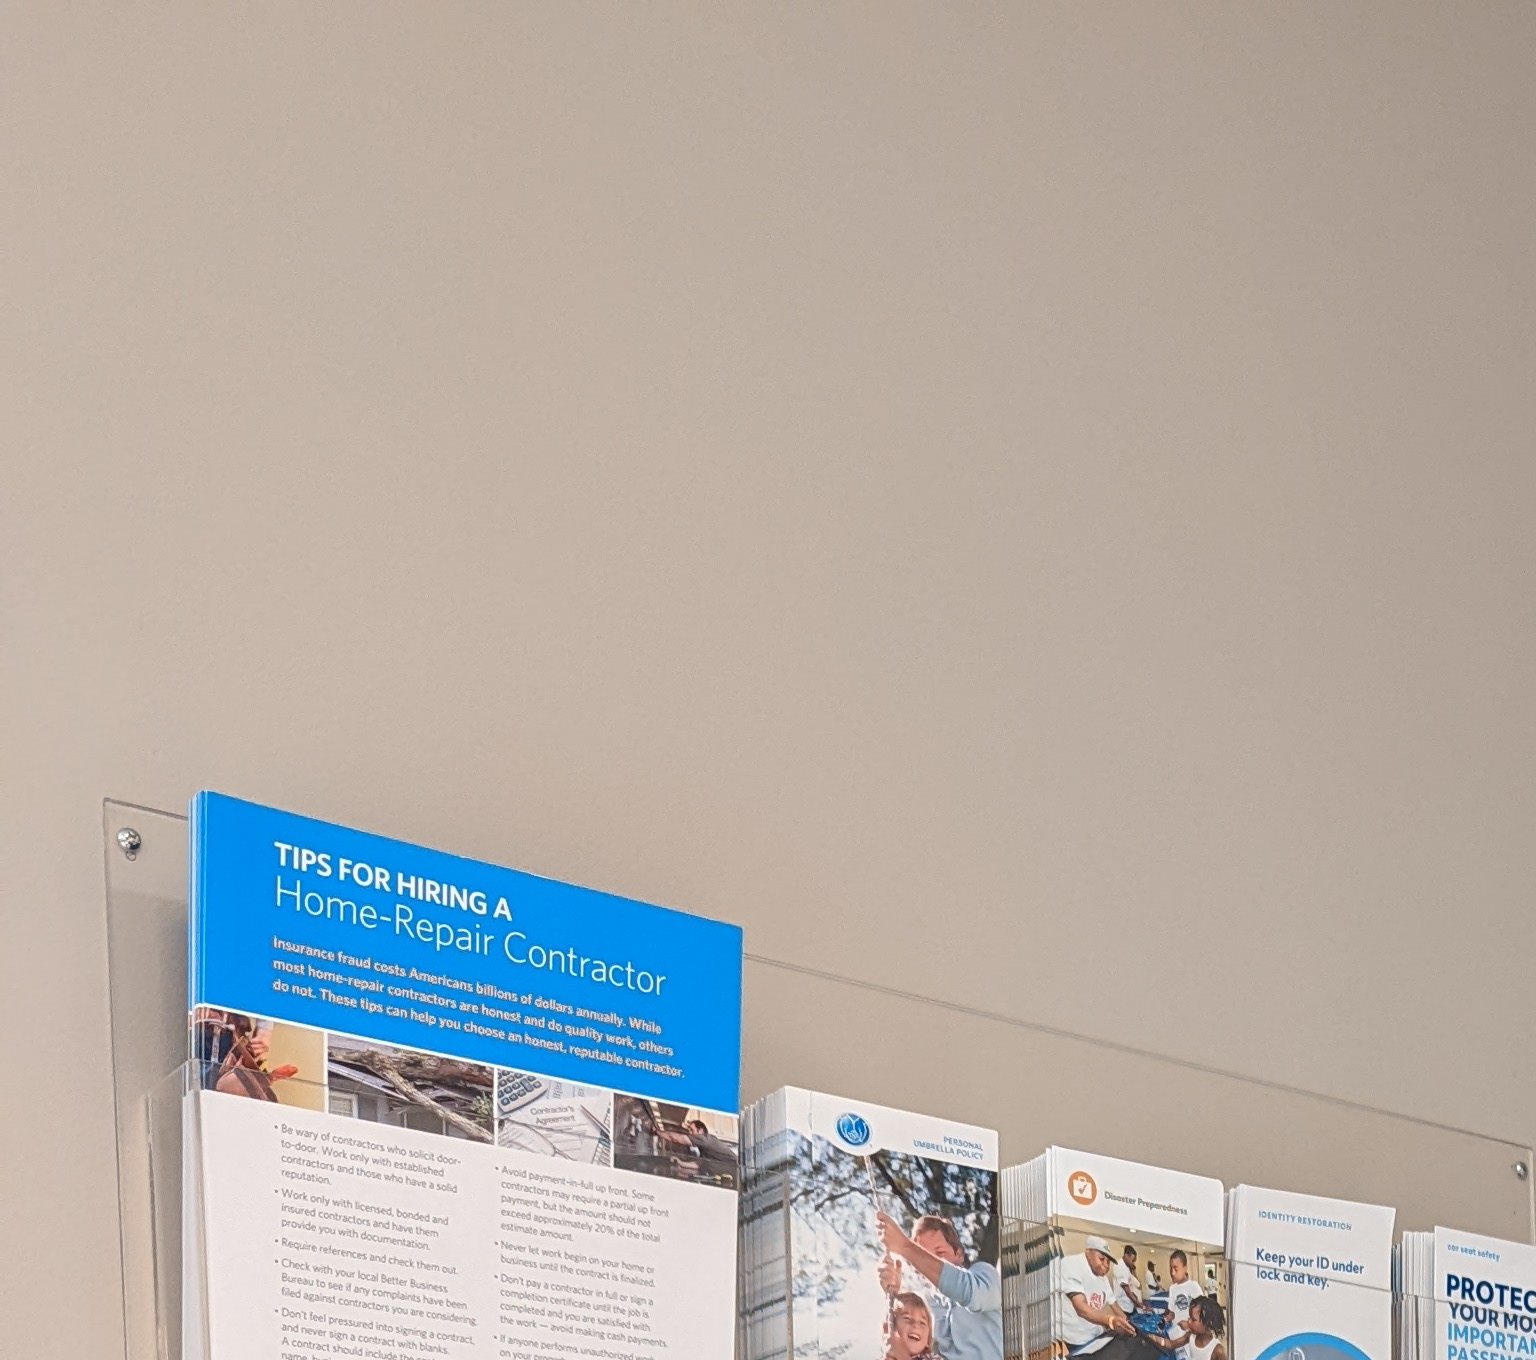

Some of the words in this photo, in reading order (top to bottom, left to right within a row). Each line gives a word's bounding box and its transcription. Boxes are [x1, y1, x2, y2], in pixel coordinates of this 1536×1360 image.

[275, 842, 331, 876] TIPS
[340, 858, 390, 891] FOR
[398, 873, 486, 914] HIRING
[494, 898, 512, 921] A
[277, 876, 494, 954] Home-Repair
[505, 932, 666, 995] Contractor
[273, 935, 335, 961] Insurance
[338, 951, 370, 969] fraud
[374, 961, 406, 977] costs
[409, 967, 473, 992] Americans
[476, 982, 518, 1002] billions
[521, 994, 532, 1005] of
[534, 996, 573, 1015] dollars
[576, 1007, 626, 1027] annually.
[629, 1017, 661, 1034] While
[282, 1124, 293, 1134] Be
[295, 1128, 318, 1141] wary
[321, 1132, 330, 1141] of
[332, 1135, 385, 1150] contractors
[387, 1145, 407, 1156] who
[409, 1149, 435, 1162] solicit
[914, 1140, 955, 1154] UMBRELLA
[957, 1146, 983, 1160] POLICY
[944, 1136, 983, 1151] PERSONAL
[1104, 1191, 1136, 1205] Disaster
[1138, 1197, 1188, 1215] Preparedness
[1258, 1210, 1295, 1223] IDENTITY
[1298, 1216, 1352, 1232] RESTORATION
[1256, 1248, 1286, 1267] Keep
[1289, 1256, 1314, 1268] your
[1317, 1256, 1329, 1269] ID
[1332, 1261, 1364, 1274] under
[1448, 1244, 1459, 1252] car
[1461, 1246, 1476, 1256] seat
[1478, 1249, 1500, 1262] safety
[1257, 1268, 1280, 1281] lock
[1283, 1272, 1305, 1283] and
[1307, 1274, 1329, 1289] key.
[1449, 1302, 1498, 1326] YOUR
